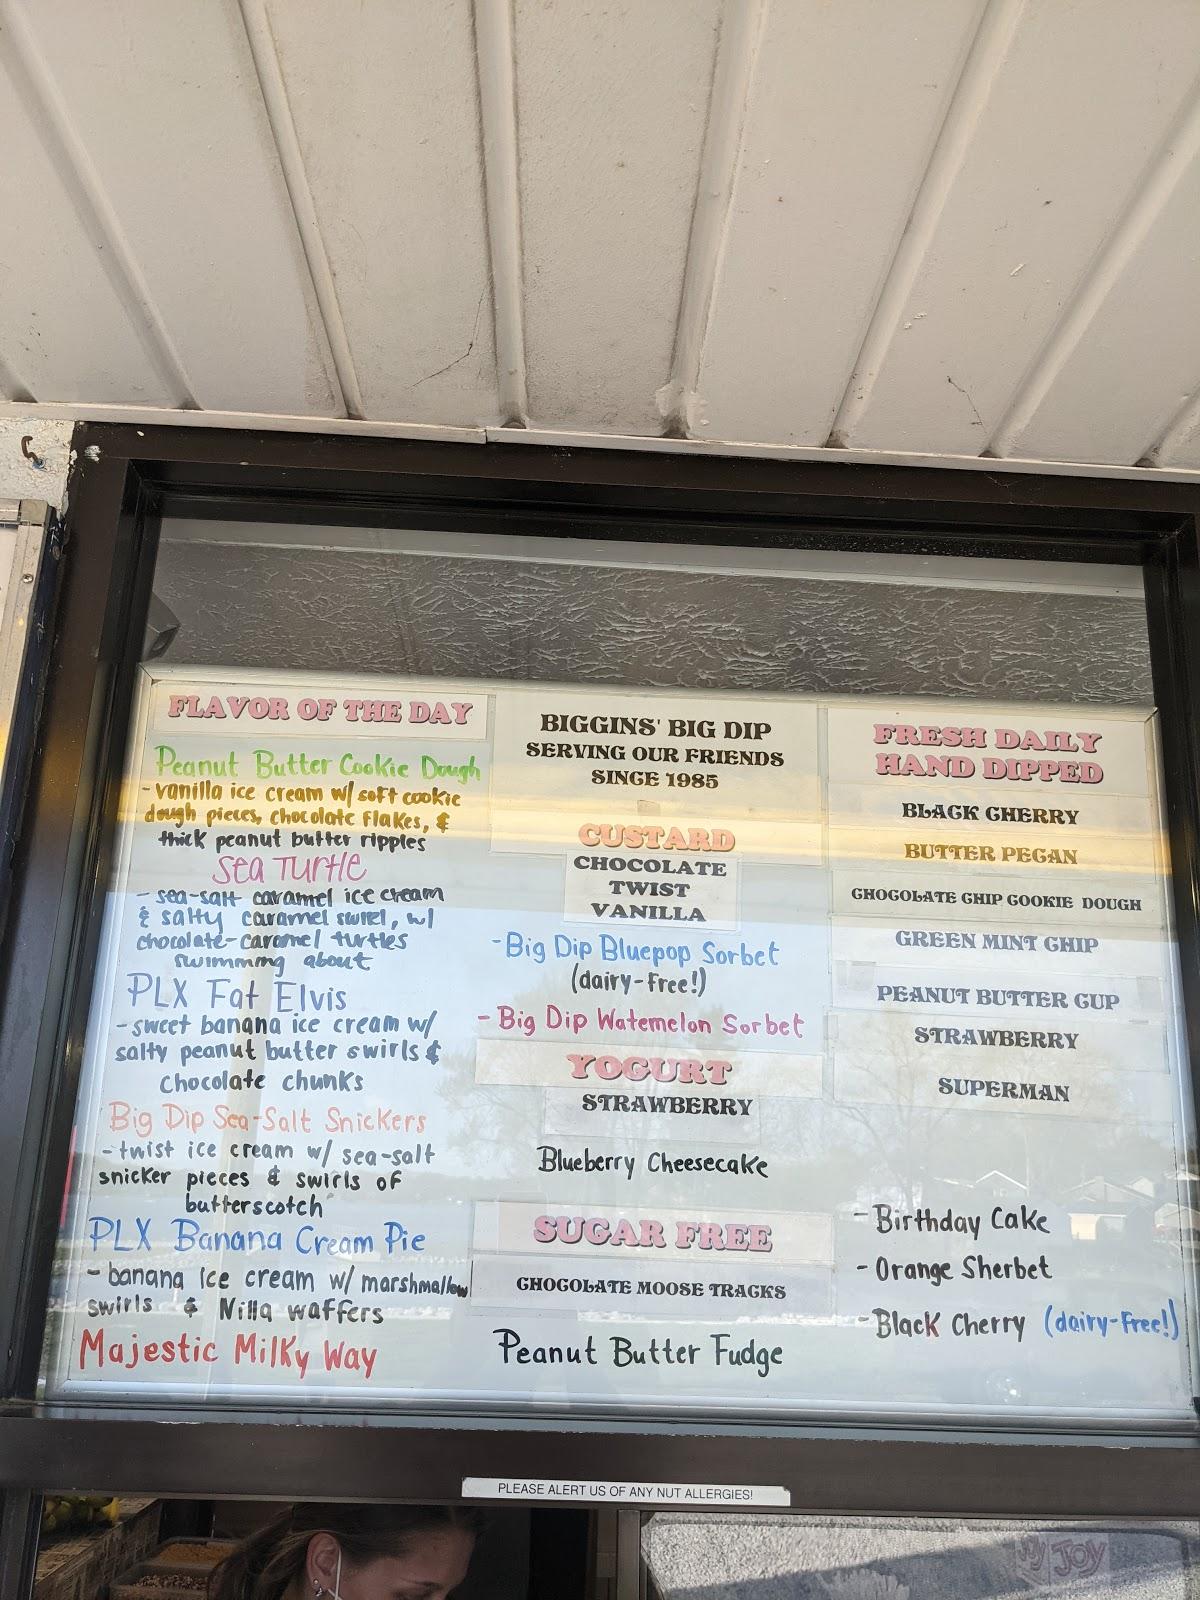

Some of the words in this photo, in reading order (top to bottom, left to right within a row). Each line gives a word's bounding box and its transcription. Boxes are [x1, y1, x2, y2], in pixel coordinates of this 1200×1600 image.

[168, 695, 290, 720] FLAVOR
[297, 698, 337, 721] OF
[343, 700, 402, 723] THE
[408, 701, 474, 725] DAY
[540, 713, 662, 736] BIGGINS'
[668, 719, 716, 739] BIG
[723, 721, 772, 741] DIP
[873, 723, 986, 748] FRESH
[994, 728, 1102, 753] DAILY
[153, 745, 238, 779] Peanut
[252, 750, 331, 779] Butter
[340, 753, 409, 779] Cookie
[421, 755, 481, 784] Dough
[526, 742, 626, 760] SERVING
[631, 745, 679, 762] OUR
[684, 748, 785, 767] FRIENDS
[875, 752, 976, 778] HAND
[982, 757, 1105, 785] DIPPED
[591, 769, 660, 787] SINCE
[665, 772, 719, 789] 1985
[231, 782, 255, 800] ice
[265, 785, 323, 802] cream
[332, 781, 353, 808] w/
[402, 787, 461, 807] cookie
[144, 803, 196, 828] dough
[270, 806, 354, 826] chocolate
[436, 812, 450, 833] &
[901, 802, 980, 821] BLACK
[985, 806, 1080, 825] CHERRY
[158, 829, 207, 849] thick
[216, 833, 281, 853] peanut
[291, 832, 351, 848] butter
[360, 834, 426, 852] ripples
[578, 822, 736, 852] CUSTARD
[273, 852, 368, 884] Turtle
[573, 855, 727, 877] CHOCOLATE
[904, 843, 996, 862] BUTTER
[1001, 846, 1078, 865] PECAN
[252, 889, 333, 908] caramel
[344, 888, 374, 905] ice
[379, 887, 445, 903] cream
[608, 880, 691, 898] TWIST
[851, 887, 957, 905] CHOCOLATE
[961, 892, 1003, 906] CHIP
[1006, 894, 1074, 909] COOKIE
[1081, 897, 1142, 912] DOUGH
[138, 906, 150, 929] &
[161, 908, 223, 934] salty
[241, 909, 328, 926] caramel
[407, 908, 435, 928] w/
[590, 902, 707, 923] VANILLA
[136, 929, 321, 950] chocolate-caramel
[330, 931, 409, 951] turtles
[554, 935, 592, 962] Dip
[599, 934, 691, 967] Bluepop
[702, 941, 780, 966] Sorbet
[895, 930, 976, 950] GREEN
[982, 933, 1039, 951] MINT
[1044, 936, 1099, 953] CHIP
[174, 953, 285, 977] swimming
[303, 951, 374, 971] about
[127, 972, 188, 1009] PLX
[206, 978, 260, 1009] Fat
[274, 981, 347, 1013] Elvis
[876, 985, 970, 1005] PEANUT
[976, 989, 1069, 1009] BUTTER
[1074, 993, 1120, 1011] CUP
[201, 1015, 280, 1036] banana
[292, 1013, 319, 1034] ice
[333, 1016, 399, 1035] cream
[407, 1010, 438, 1040] w/
[546, 1004, 588, 1034] Dip
[597, 1008, 711, 1035] Watemelon
[722, 1013, 805, 1039] Sorbet
[914, 1026, 1080, 1050] STRAWBERRY
[115, 1041, 168, 1063] salty
[180, 1041, 257, 1067] peanut
[265, 1040, 336, 1061] butter
[347, 1039, 418, 1060] swirls
[425, 1040, 441, 1065] &
[160, 1069, 266, 1094] chocolate
[282, 1070, 364, 1093] chunks
[566, 1054, 733, 1085] YOGURT
[938, 1077, 1070, 1103] SUPERMAN
[108, 1100, 153, 1138] Big
[161, 1103, 205, 1134] Dip
[213, 1104, 312, 1134] Sea-Salt
[325, 1106, 427, 1134] Snickers
[582, 1094, 754, 1116] STRAWBERRY
[188, 1140, 216, 1159] ice
[230, 1142, 294, 1159] cream
[306, 1139, 333, 1168] w/
[342, 1144, 436, 1167] sea-salt
[536, 1145, 635, 1180] Blueberry
[647, 1151, 769, 1178] Cheesecake
[98, 1167, 172, 1187] snicker
[186, 1171, 251, 1191] pieces
[267, 1164, 281, 1188] &
[295, 1169, 361, 1191] swirls
[185, 1196, 324, 1218] butterscotch
[991, 1205, 1050, 1233] Cake
[88, 1217, 154, 1254] PLX
[170, 1217, 283, 1253] Banana
[295, 1225, 375, 1256] Cream
[384, 1221, 425, 1256] Pie
[533, 1215, 667, 1248] SUGAR
[675, 1221, 773, 1252] FREE
[961, 1254, 1052, 1280] Sherbet
[200, 1266, 230, 1290] ice
[245, 1268, 315, 1292] cream
[330, 1266, 355, 1296] w/
[362, 1272, 469, 1299] marshmallow
[516, 1277, 632, 1295] CHOCOLATE
[636, 1281, 704, 1297] MOOSE
[708, 1283, 787, 1300] TRACKS
[87, 1295, 153, 1318] swirls
[183, 1296, 198, 1318] &
[219, 1297, 272, 1323] Nilla
[288, 1299, 384, 1325] waffers
[951, 1312, 1026, 1342] Cherry
[79, 1328, 218, 1370] Majestic
[235, 1332, 310, 1379] Milky
[324, 1339, 378, 1379] Way
[492, 1328, 598, 1364] Peanut
[609, 1336, 701, 1368] Butter
[710, 1333, 783, 1378] Fudge
[498, 1483, 544, 1495] PLEASE
[548, 1484, 587, 1496] ALERT
[590, 1485, 606, 1497] US
[609, 1486, 627, 1497] OF
[629, 1486, 654, 1498] ANY
[657, 1487, 682, 1499] NUT
[684, 1488, 753, 1500] ALLERGIES!
